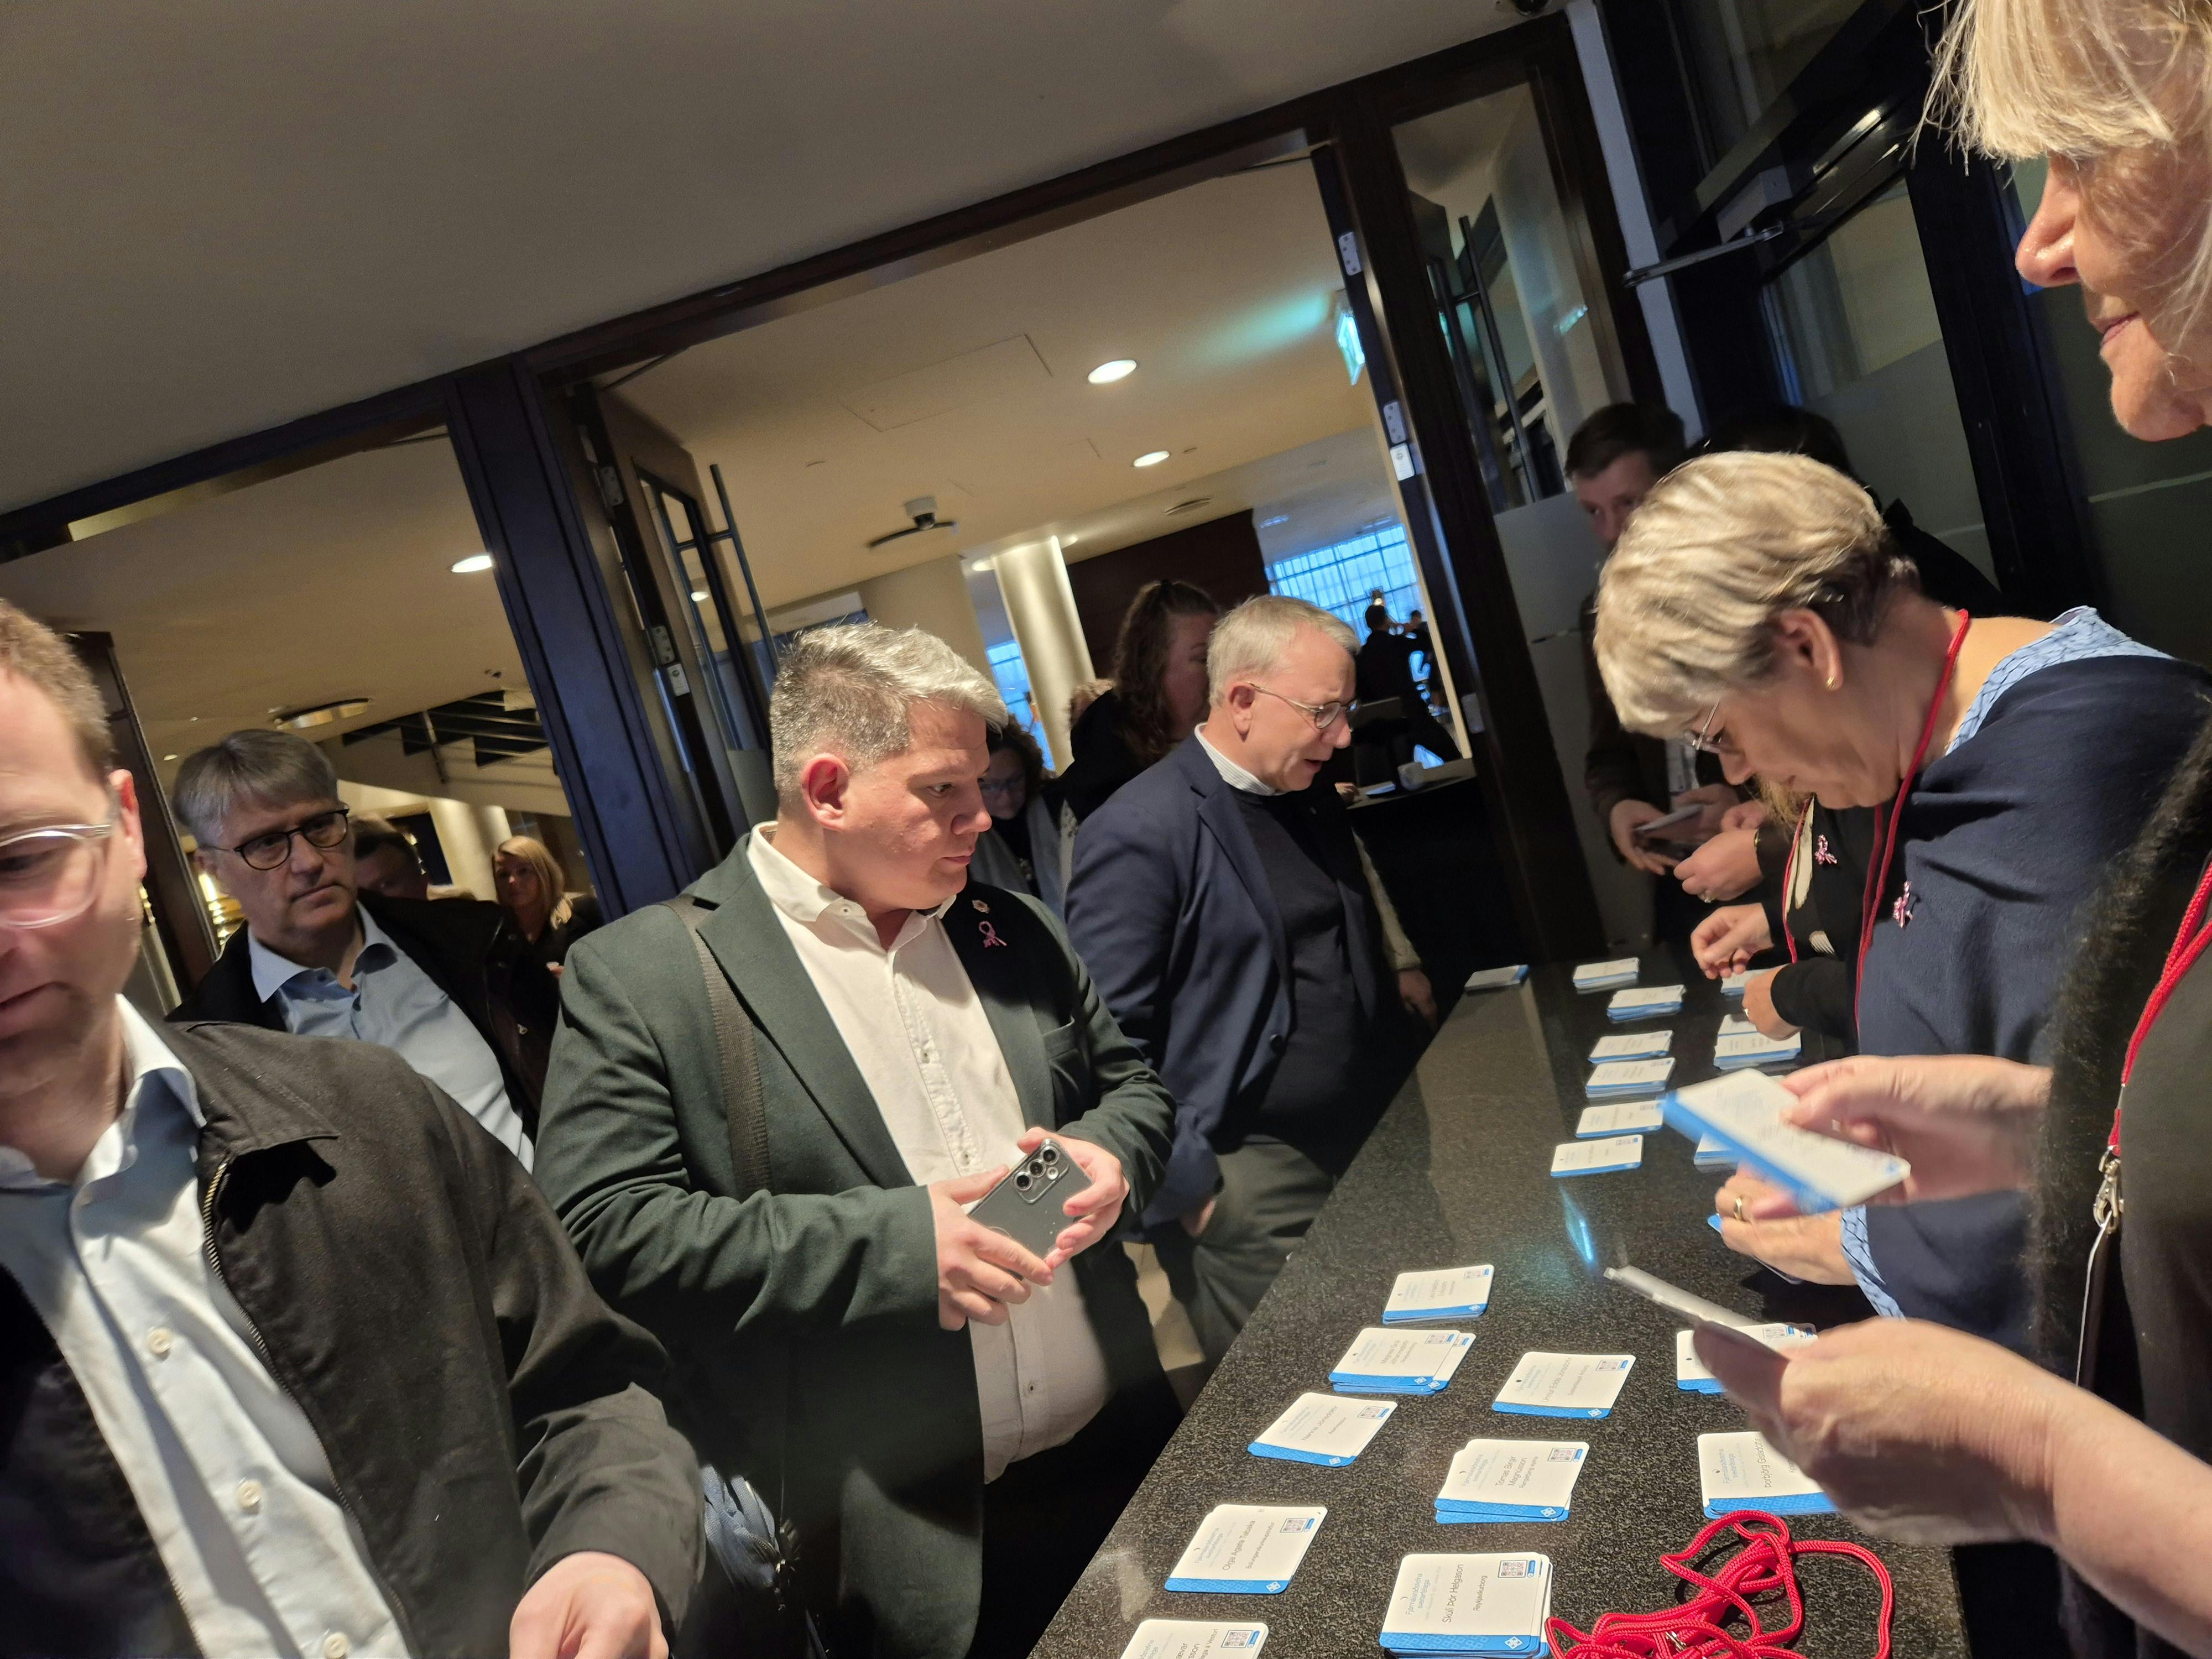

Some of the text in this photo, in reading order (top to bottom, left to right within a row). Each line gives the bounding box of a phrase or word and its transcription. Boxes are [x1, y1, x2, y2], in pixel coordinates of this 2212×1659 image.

[1495, 1455, 1518, 1486] Tómas Birgir
[1508, 1457, 1528, 1486] Magnússon
[1761, 1464, 1772, 1488] Þorbjörg
[1222, 1556, 1237, 1571] Olga
[1231, 1540, 1246, 1556] Agata
[1239, 1520, 1256, 1538] Tabaka
[1442, 1563, 1465, 1623] Skúli Þór Helgason
[1473, 1575, 1488, 1611] Reykjavíkurborg
